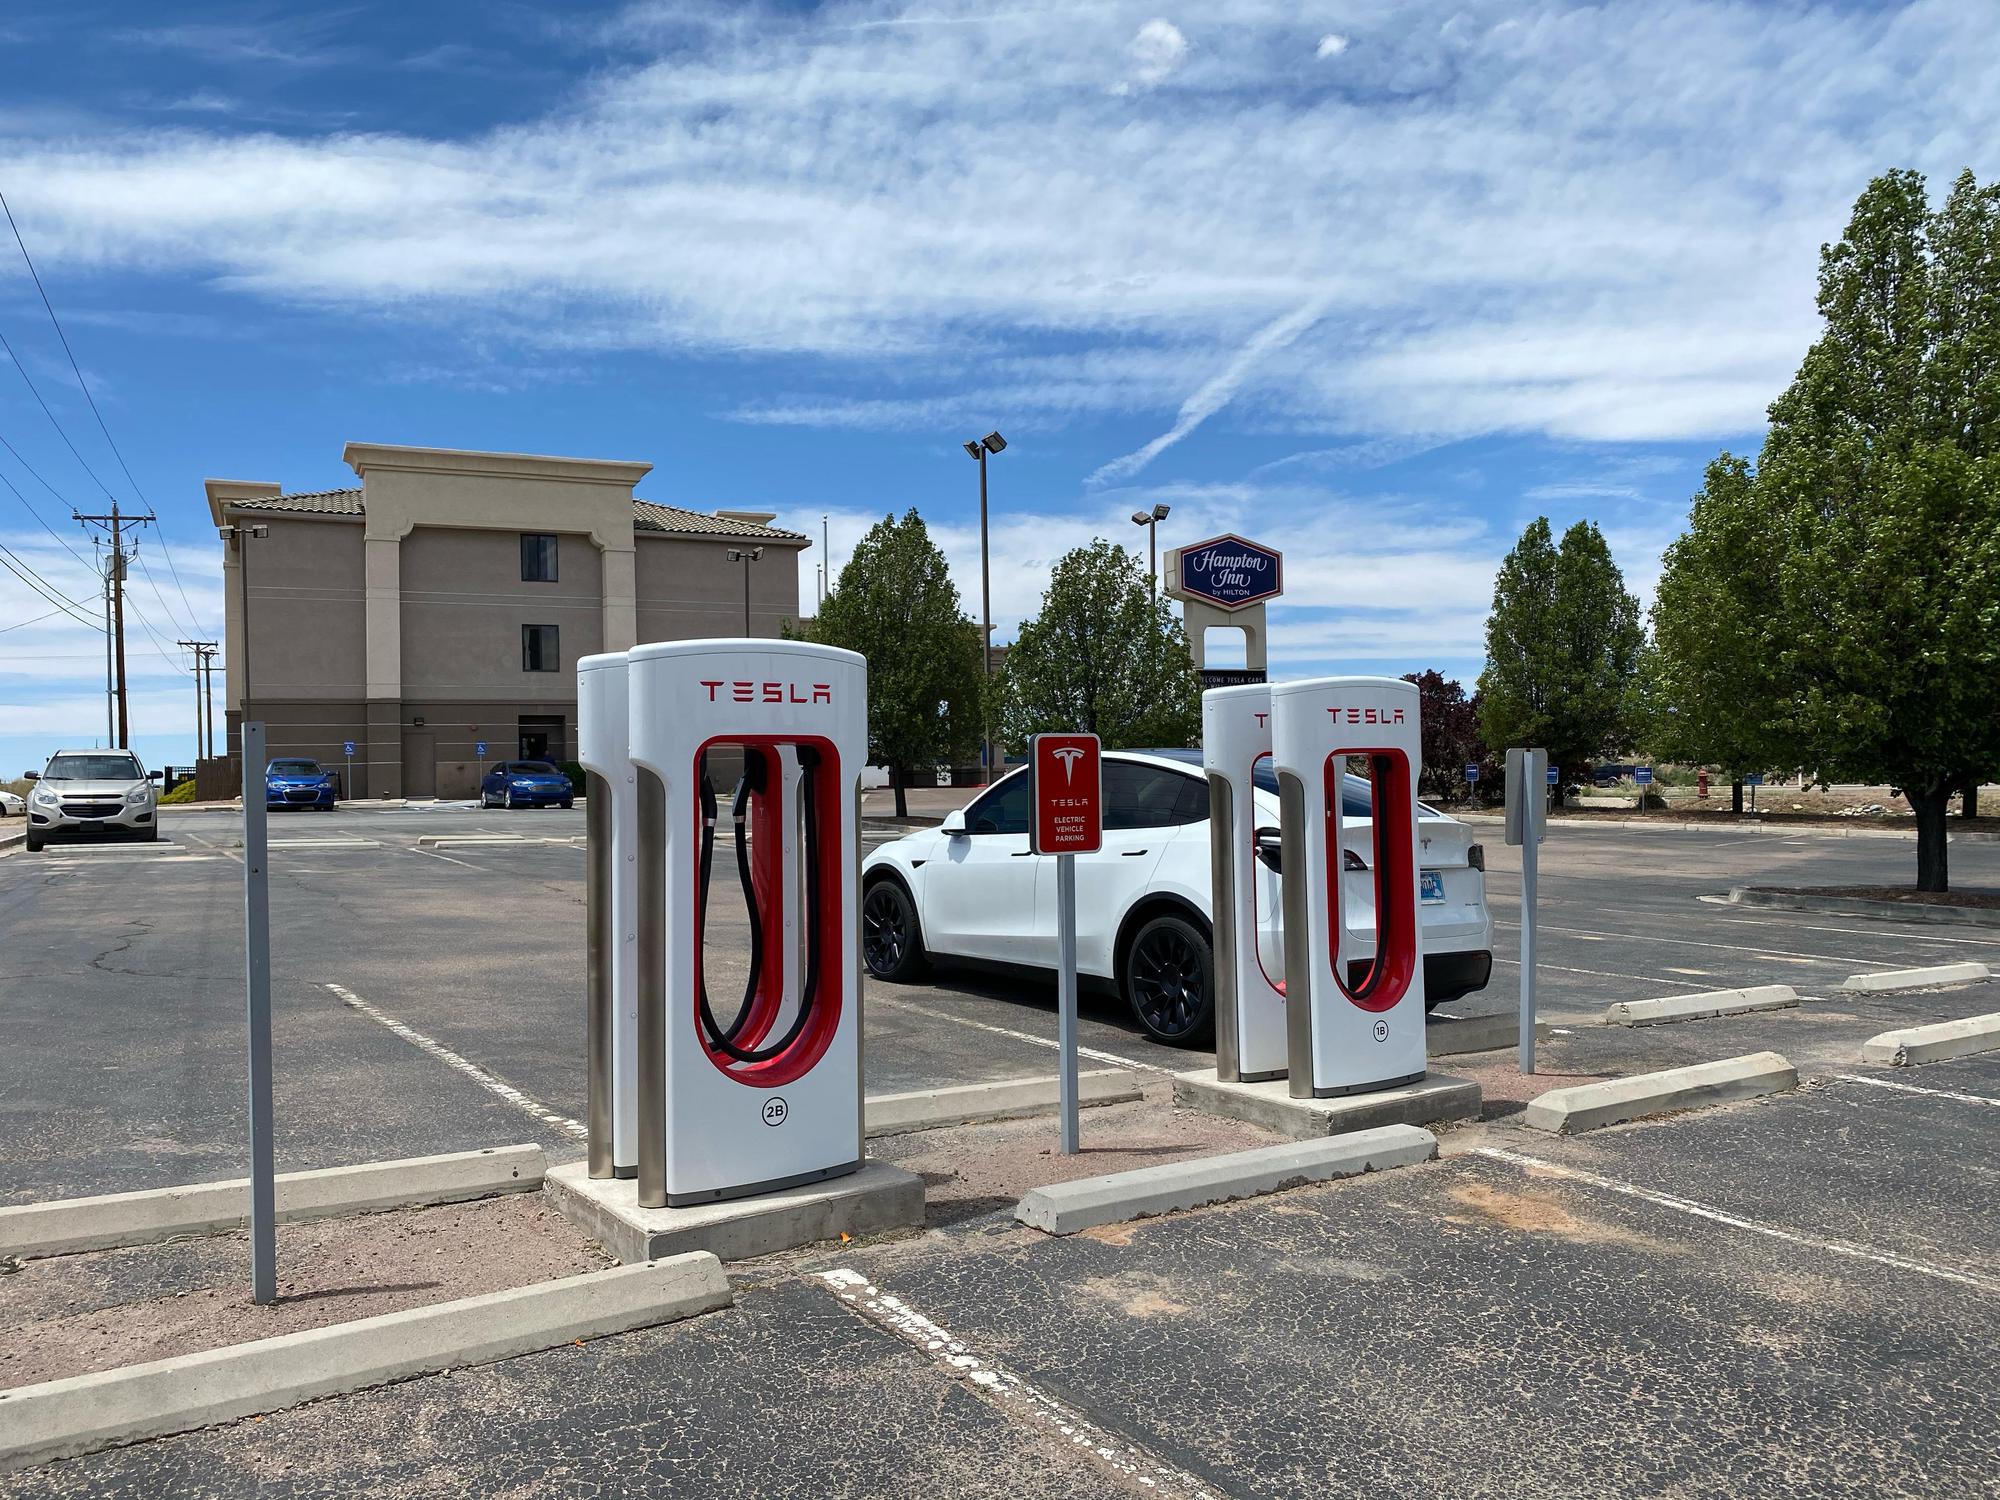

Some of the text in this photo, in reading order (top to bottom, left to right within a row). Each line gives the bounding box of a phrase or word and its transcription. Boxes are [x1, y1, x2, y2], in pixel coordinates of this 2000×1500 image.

[1193, 550, 1267, 571] Hampton
[1211, 569, 1250, 587] Inn
[1227, 676, 1245, 684] TESLA
[1248, 676, 1263, 684] CARS
[700, 681, 831, 704] TESLA
[1326, 708, 1404, 724] TESLA
[1051, 798, 1089, 807] TESLA
[1054, 816, 1086, 824] ELECTRIC
[1056, 825, 1084, 833] VEHICLE
[1055, 834, 1085, 842] PARKING
[1376, 1026, 1386, 1036] 1B
[766, 1104, 784, 1118] 2B
